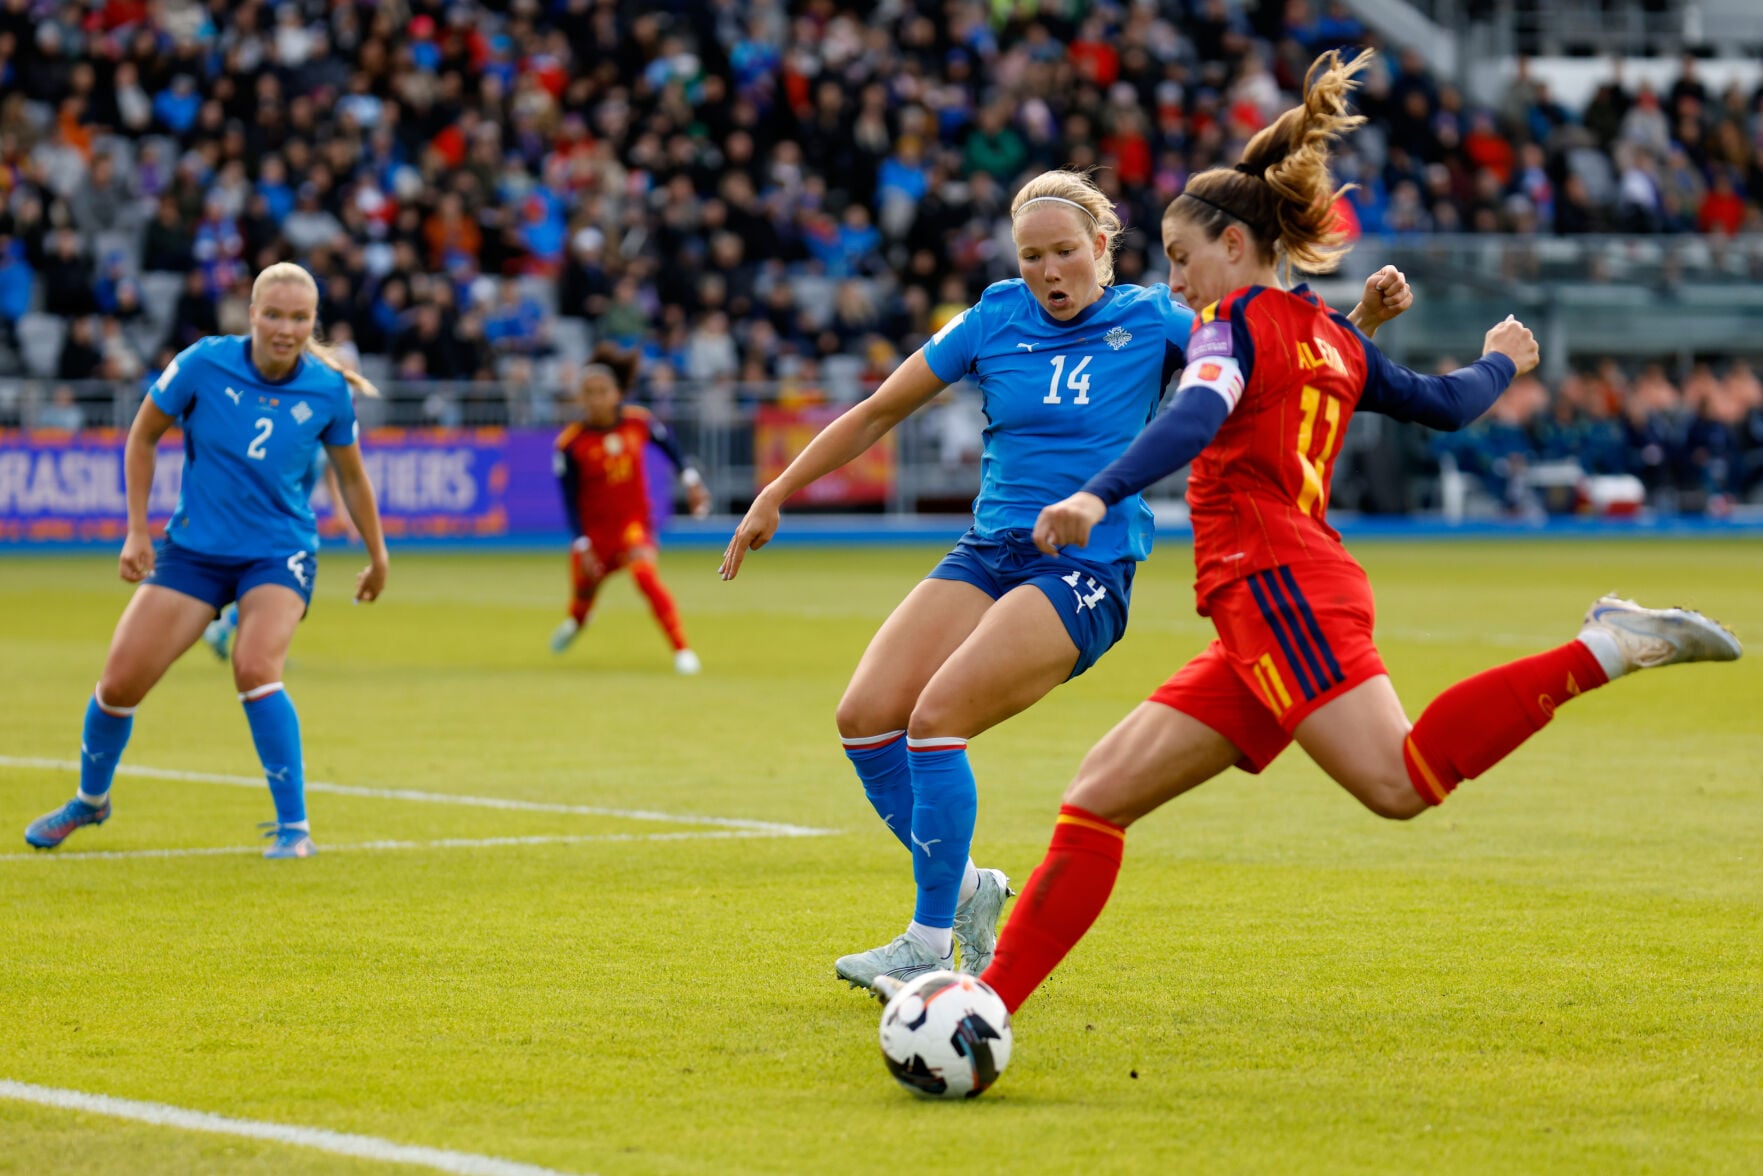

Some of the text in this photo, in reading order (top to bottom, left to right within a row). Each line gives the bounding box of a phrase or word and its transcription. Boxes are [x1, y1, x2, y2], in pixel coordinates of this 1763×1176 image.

[1043, 354, 1093, 405] 14
[247, 416, 274, 461] 2
[1296, 383, 1342, 518] 11
[1252, 652, 1293, 718] 11
